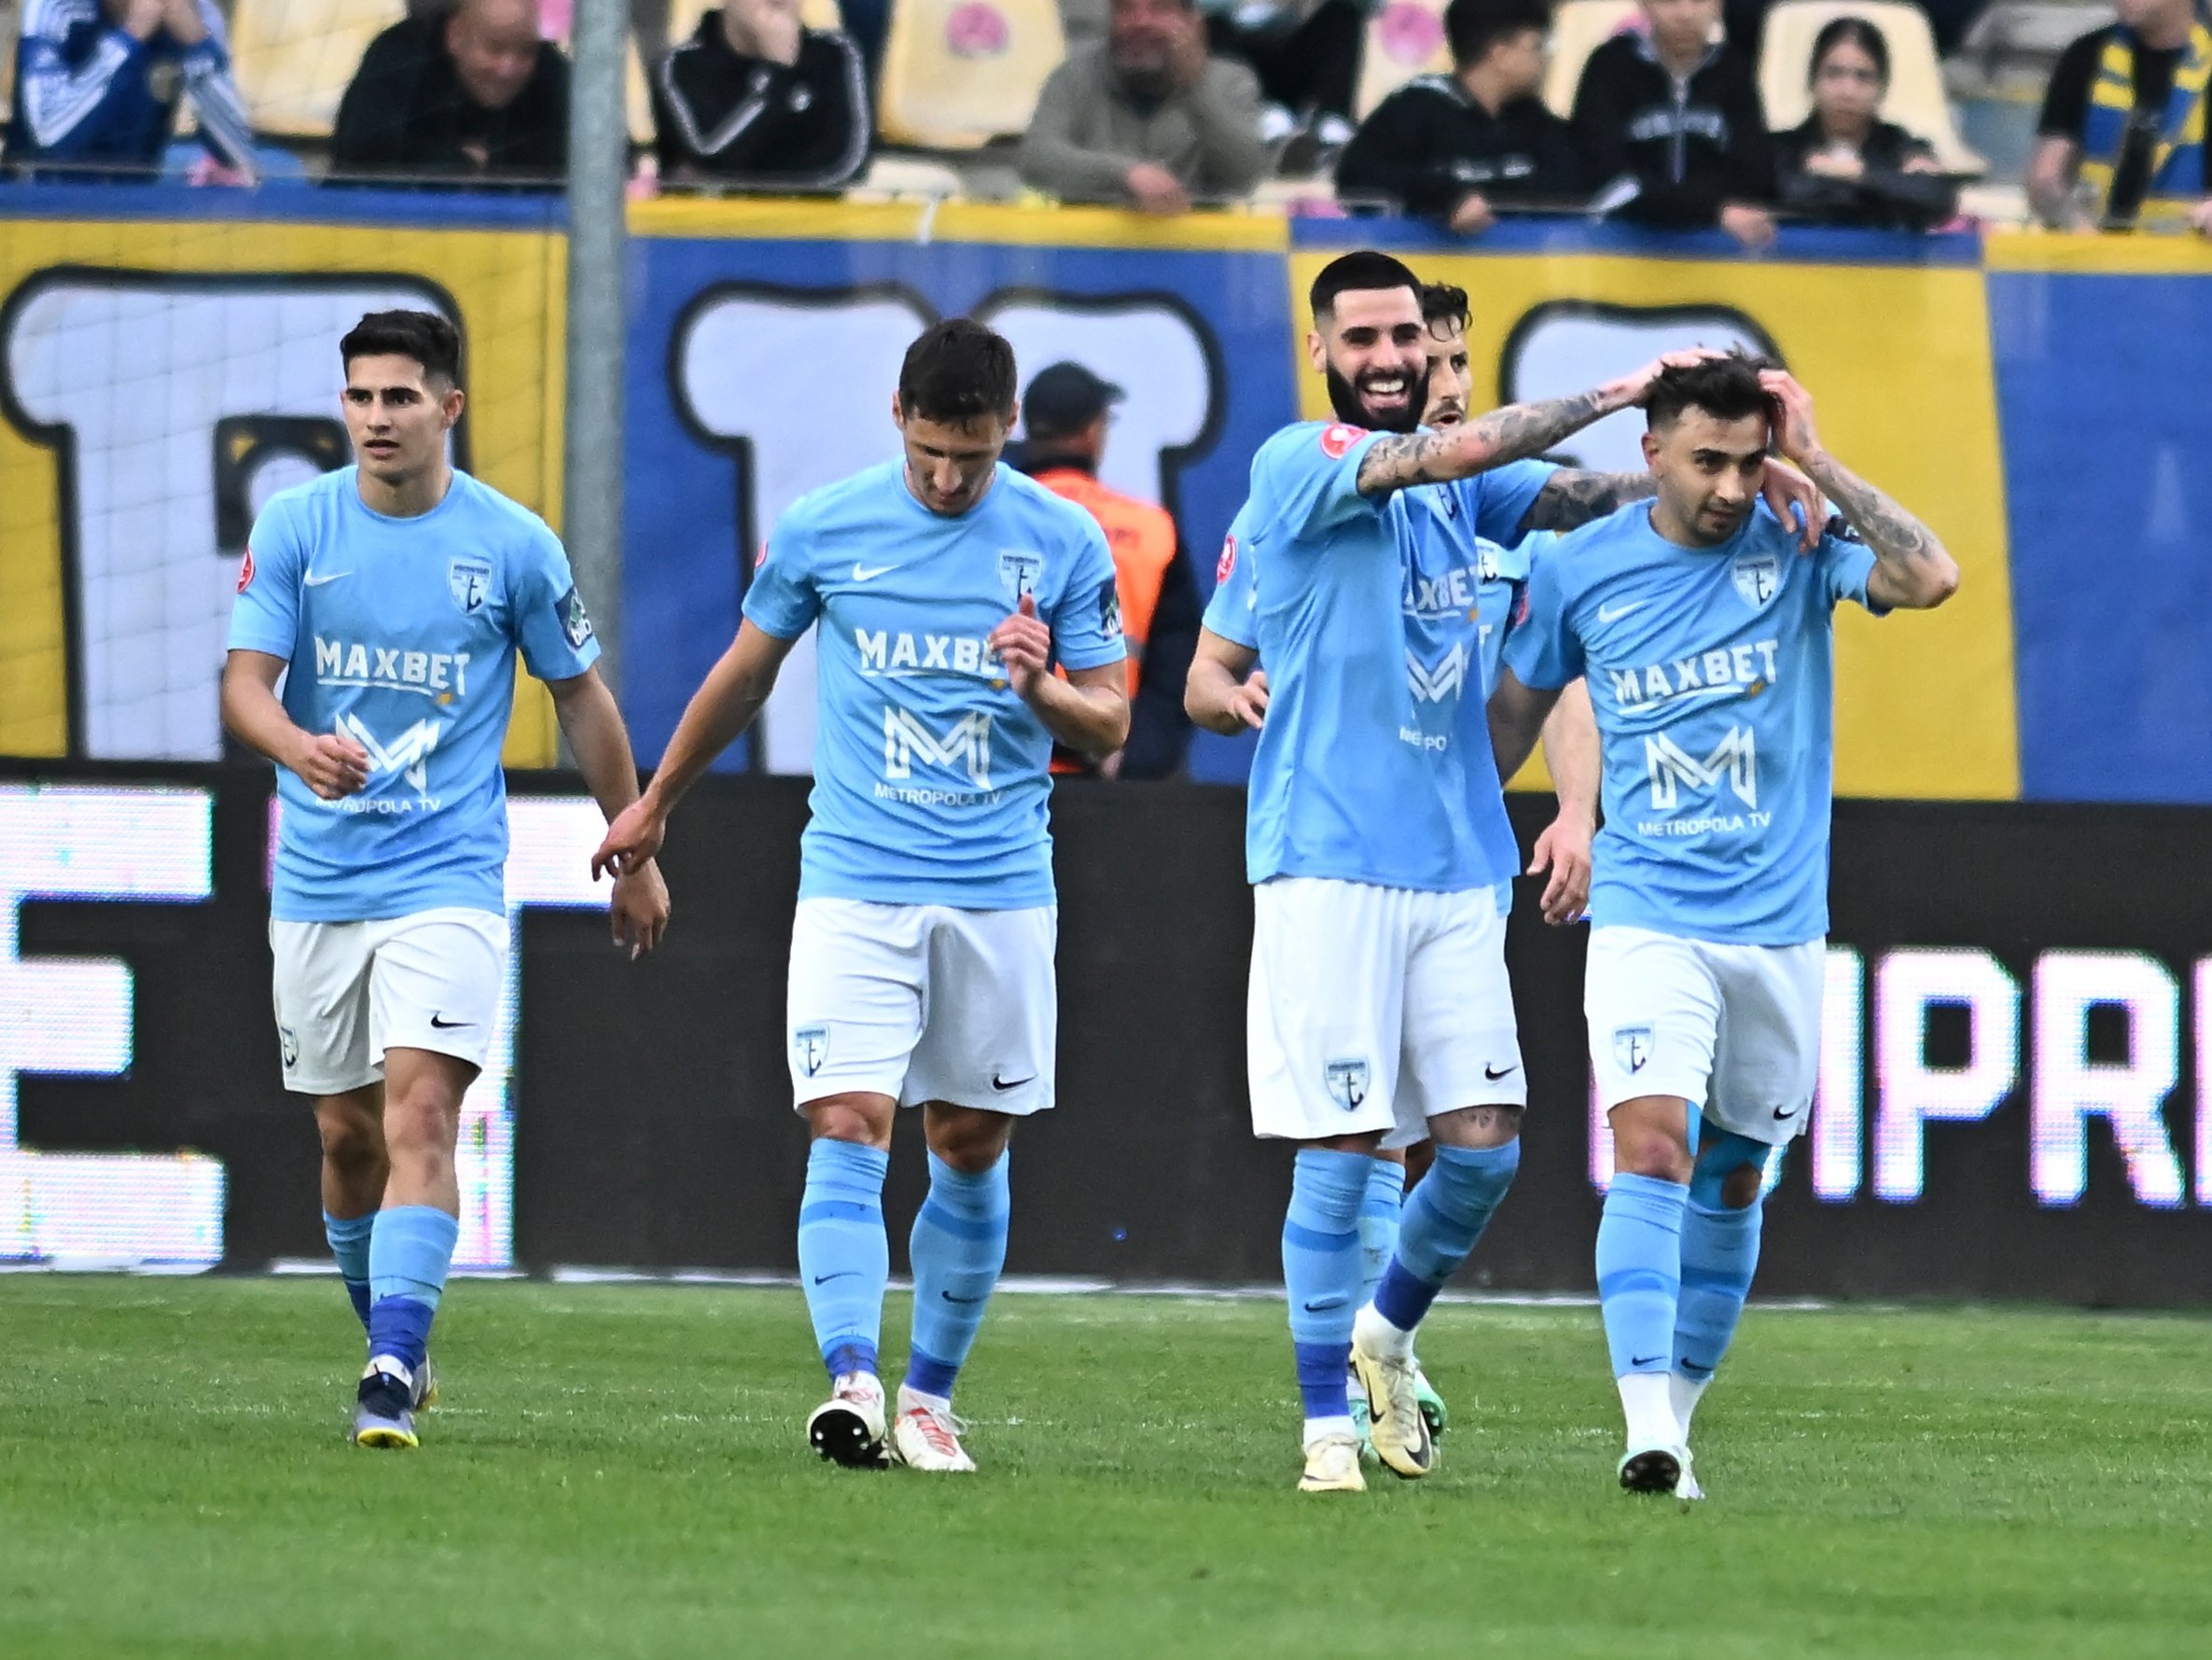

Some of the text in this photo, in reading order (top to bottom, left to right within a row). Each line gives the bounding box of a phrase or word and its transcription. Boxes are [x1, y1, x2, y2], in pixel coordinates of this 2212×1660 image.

[314, 632, 470, 696] MAXBET
[855, 628, 1002, 676] MAXBE
[1609, 639, 1778, 705] MAXBET
[417, 799, 441, 812] TV
[874, 781, 977, 806] METROPOLA
[1637, 811, 1771, 837] METROPOLA TV
